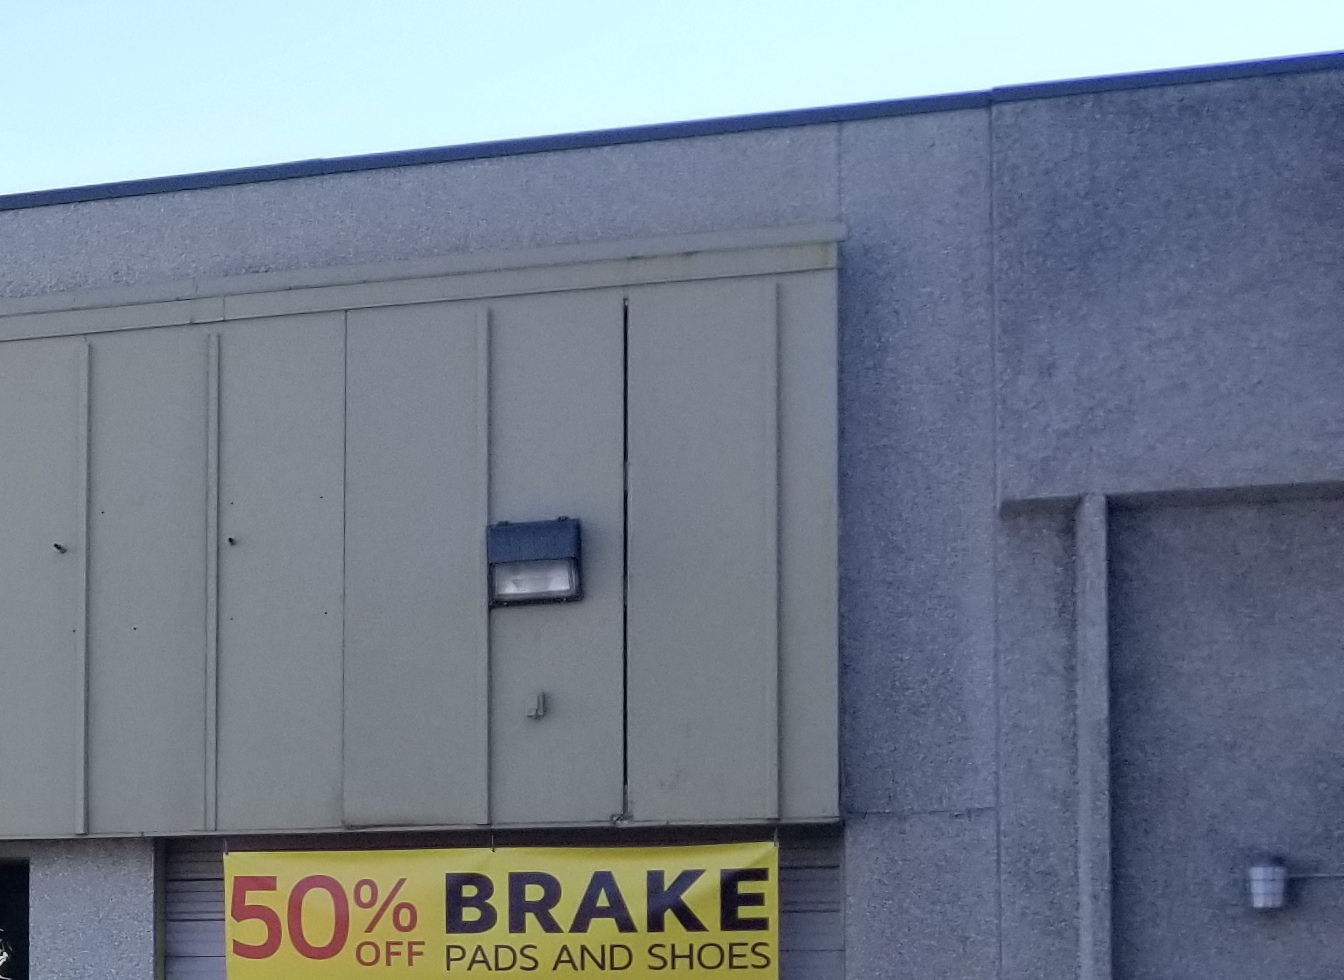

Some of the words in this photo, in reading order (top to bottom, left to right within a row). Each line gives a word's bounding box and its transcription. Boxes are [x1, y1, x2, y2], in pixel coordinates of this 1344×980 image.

[230, 873, 419, 961] 50%
[443, 867, 771, 935] BRAKE
[355, 940, 426, 967] OFF
[444, 943, 540, 973] PADS
[551, 943, 634, 972] AND
[647, 941, 772, 972] SHOES
